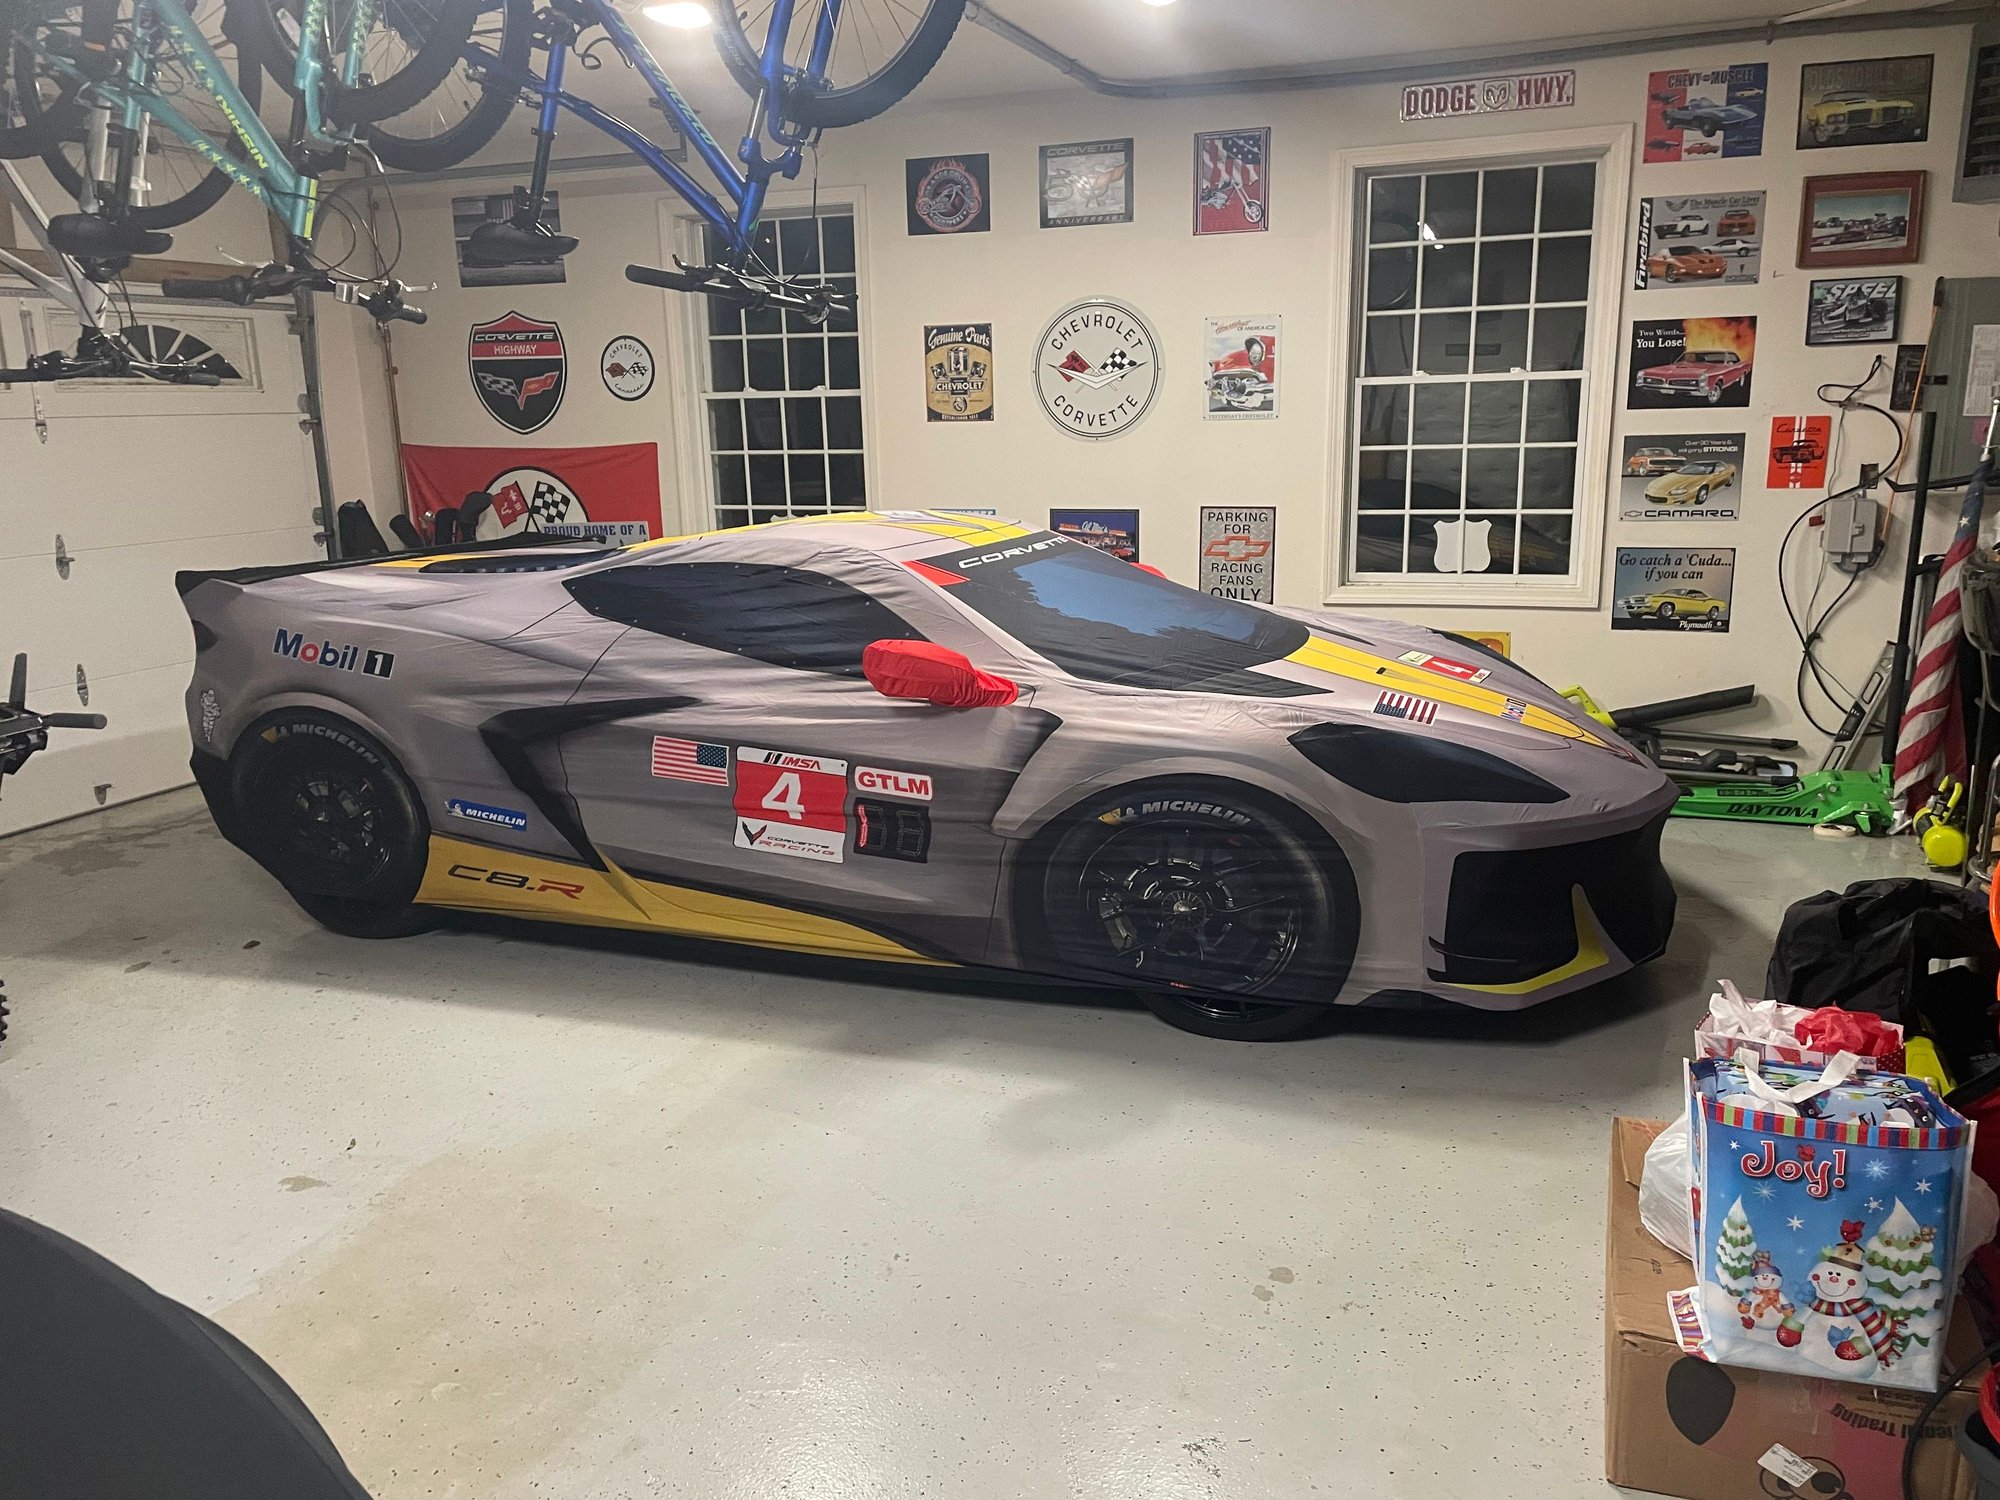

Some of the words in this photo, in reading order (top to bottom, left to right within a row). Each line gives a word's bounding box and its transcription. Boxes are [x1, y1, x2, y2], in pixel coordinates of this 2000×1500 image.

[1667, 72, 1703, 89] CHEVY
[1710, 67, 1755, 85] MUSCLE
[1405, 84, 1477, 117] DODGE
[1517, 75, 1571, 106] HWY.
[215, 94, 269, 169] NISHIKI
[1047, 142, 1125, 156] CORVETTE
[1048, 214, 1126, 226] ANNIVERSARY
[1635, 201, 1652, 289] Firebird
[475, 332, 555, 341] CORVETTE
[928, 327, 964, 349] Genuine
[965, 326, 990, 347] Parts
[1051, 313, 1144, 350] CHEVROLET
[1639, 329, 1655, 337] Two
[1655, 328, 1686, 336] Words...
[494, 344, 538, 355] HIGHWAY
[1636, 338, 1655, 348] You
[1657, 337, 1687, 347] Lose!
[609, 343, 643, 359] CHEVROLET
[936, 381, 983, 391] CHEVROLET
[1053, 394, 1138, 427] CORVETTE
[1208, 511, 1268, 523] PARKING
[1644, 509, 1734, 518] CAMARO
[543, 525, 580, 536] PROUD
[584, 524, 617, 536] HOME
[620, 524, 634, 535] OF
[639, 524, 647, 535] A
[1224, 523, 1251, 534] FOR
[958, 535, 1069, 569] CORVETTE
[1620, 553, 1636, 566] Go
[1640, 553, 1671, 566] catch
[1674, 557, 1682, 566] a
[1686, 553, 1732, 567] 'Cuda...
[1211, 562, 1263, 574] RACING
[1645, 567, 1656, 581] if
[1656, 570, 1678, 582] you
[1681, 570, 1704, 580] can
[1219, 575, 1254, 586] FANS
[1210, 586, 1261, 601] ONLY
[1679, 620, 1713, 631] Plymouth
[273, 628, 359, 672] Mobil
[292, 723, 378, 765] MICHELIN
[781, 756, 821, 771] IMSA
[857, 770, 930, 797] GTLM
[761, 771, 806, 821] 4
[465, 808, 526, 827] MICHELIN
[1141, 799, 1252, 826] MICHELIN
[1727, 803, 1819, 819] DAYTONA
[759, 840, 836, 856] RACING
[767, 836, 830, 849] CORVETTE
[447, 864, 585, 900] C8.R
[1740, 1140, 1847, 1198] Joy!
[1829, 1402, 1897, 1438] Trading
